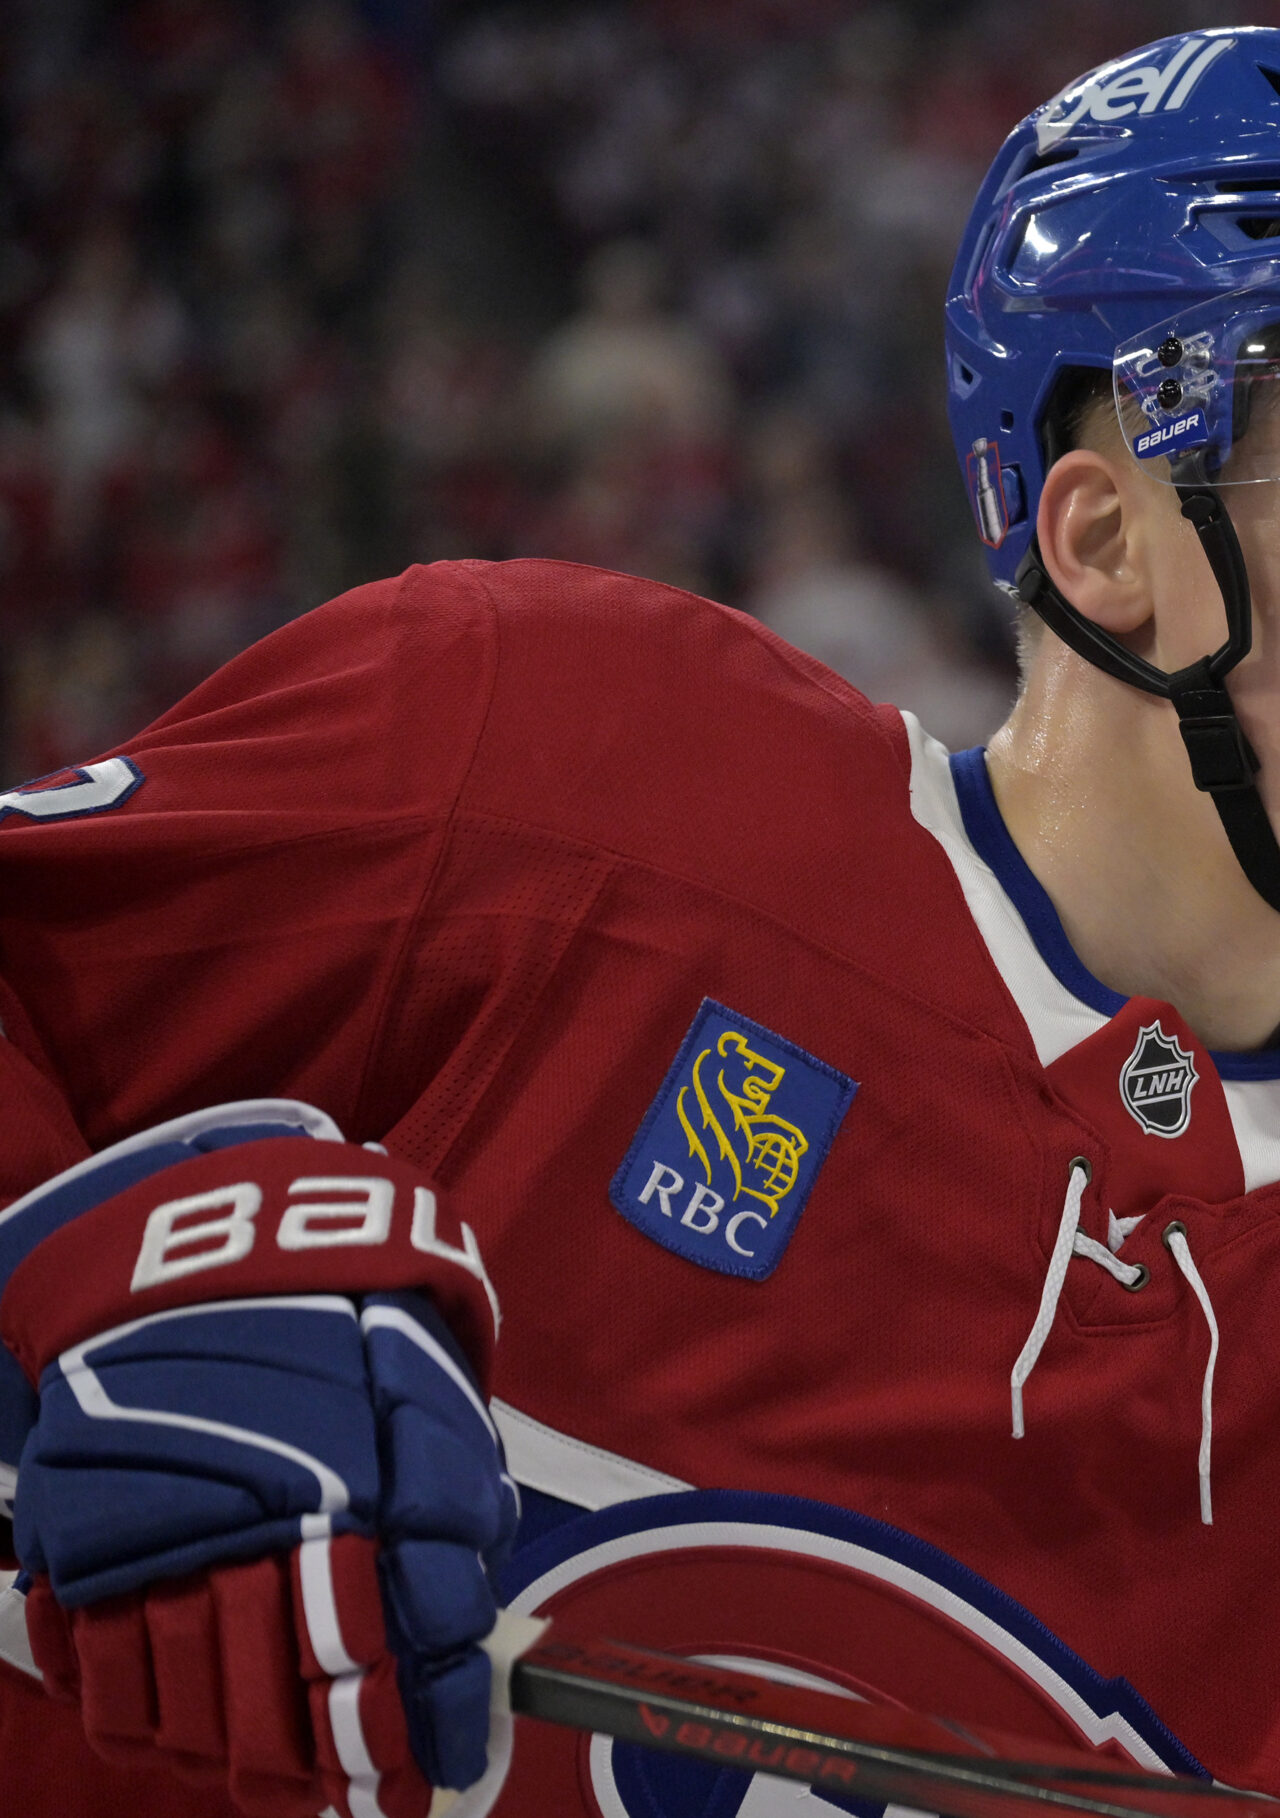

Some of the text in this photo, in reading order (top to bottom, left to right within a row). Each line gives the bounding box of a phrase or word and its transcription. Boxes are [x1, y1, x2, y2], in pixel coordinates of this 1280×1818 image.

[1137, 414, 1199, 453] BAUER
[1133, 1069, 1185, 1099] LNH
[130, 1176, 500, 1294] BAU
[637, 1160, 768, 1258] RBC
